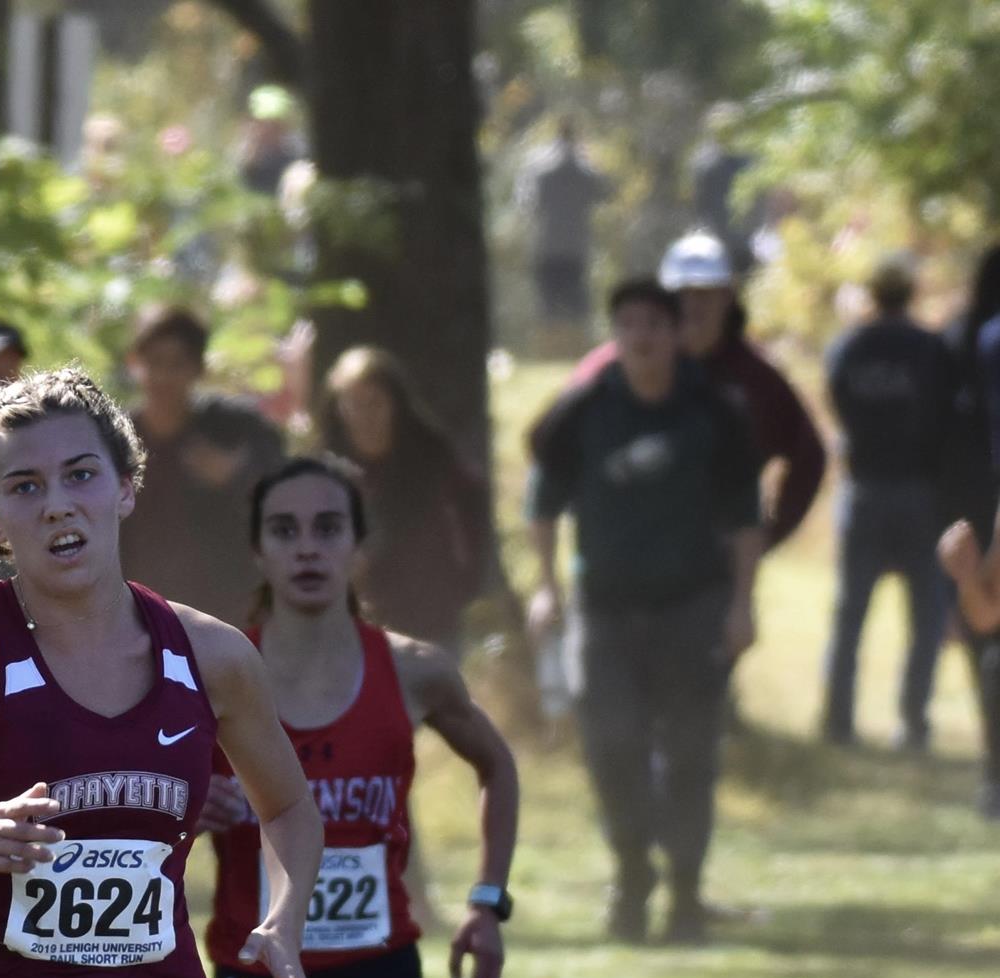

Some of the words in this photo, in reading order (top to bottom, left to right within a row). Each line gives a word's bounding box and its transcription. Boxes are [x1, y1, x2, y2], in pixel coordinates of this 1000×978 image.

[35, 771, 189, 822] AFAYETTE
[82, 849, 144, 868] asics
[22, 877, 162, 937] 2624
[306, 874, 378, 921] 522
[31, 943, 57, 953] 2019
[60, 943, 100, 953] LEHIGH
[102, 941, 163, 953] UNIVERSITY
[50, 955, 78, 964] PAUL
[81, 954, 117, 964] SHORT
[121, 954, 144, 963] RUN
